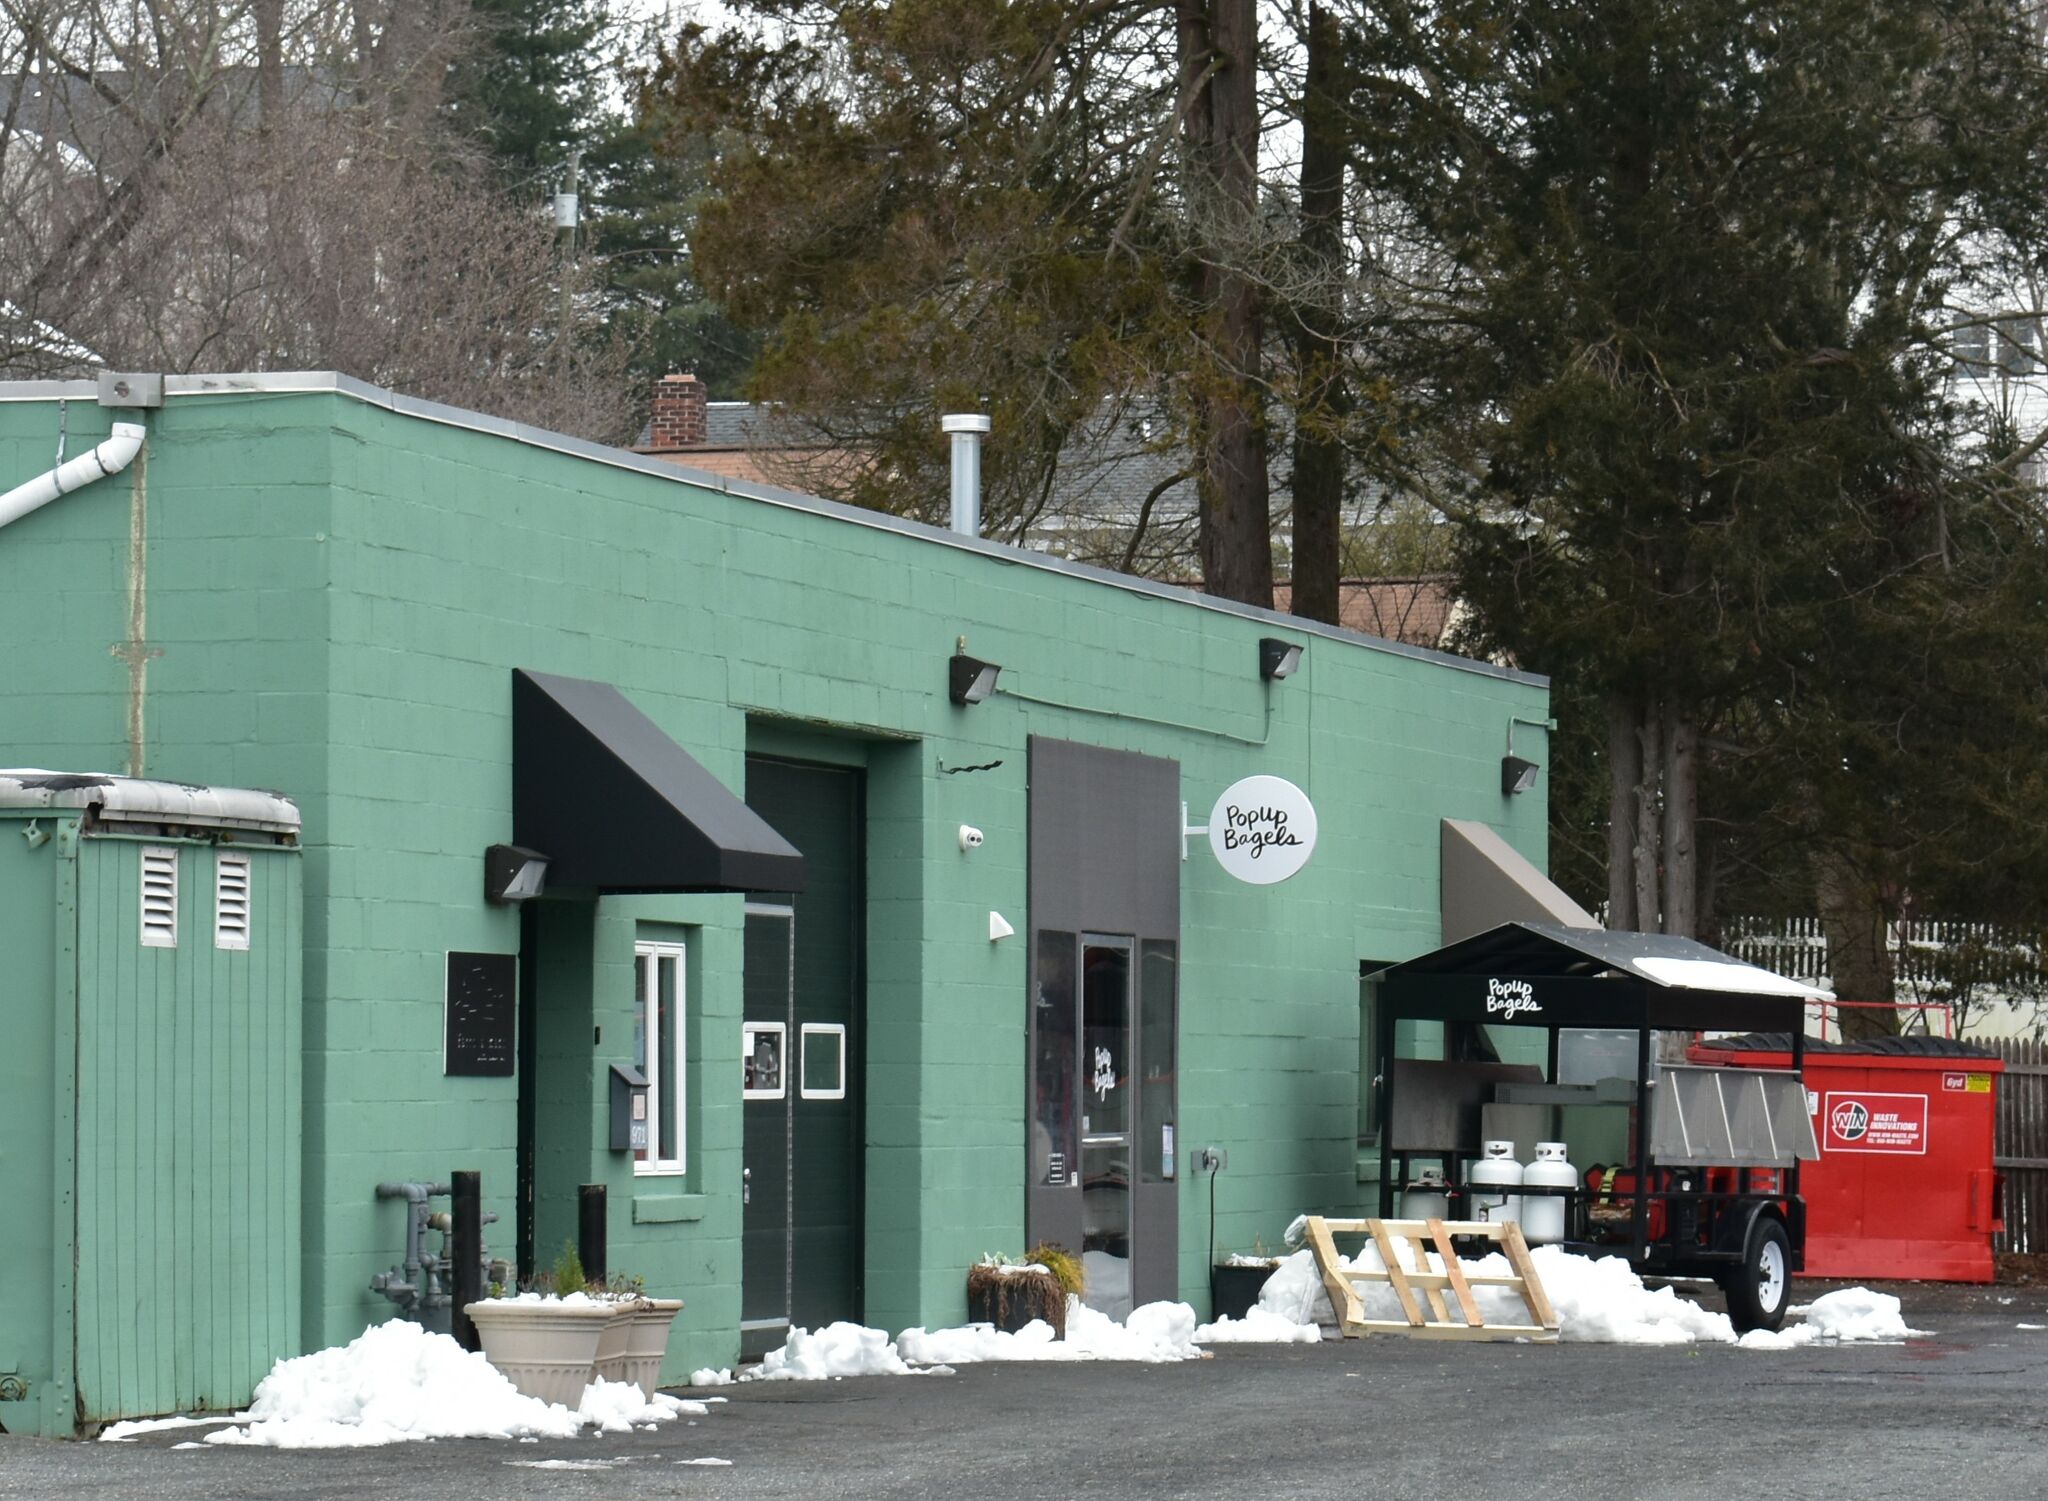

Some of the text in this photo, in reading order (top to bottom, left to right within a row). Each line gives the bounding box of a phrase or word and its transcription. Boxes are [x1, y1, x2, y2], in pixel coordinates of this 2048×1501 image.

[1224, 825, 1304, 859] Bagels
[1486, 995, 1543, 1020] Bagels
[1835, 1112, 1866, 1129] WIN
[1869, 1121, 1918, 1131] INNOVATIONS
[1873, 1113, 1898, 1122] WASTE
